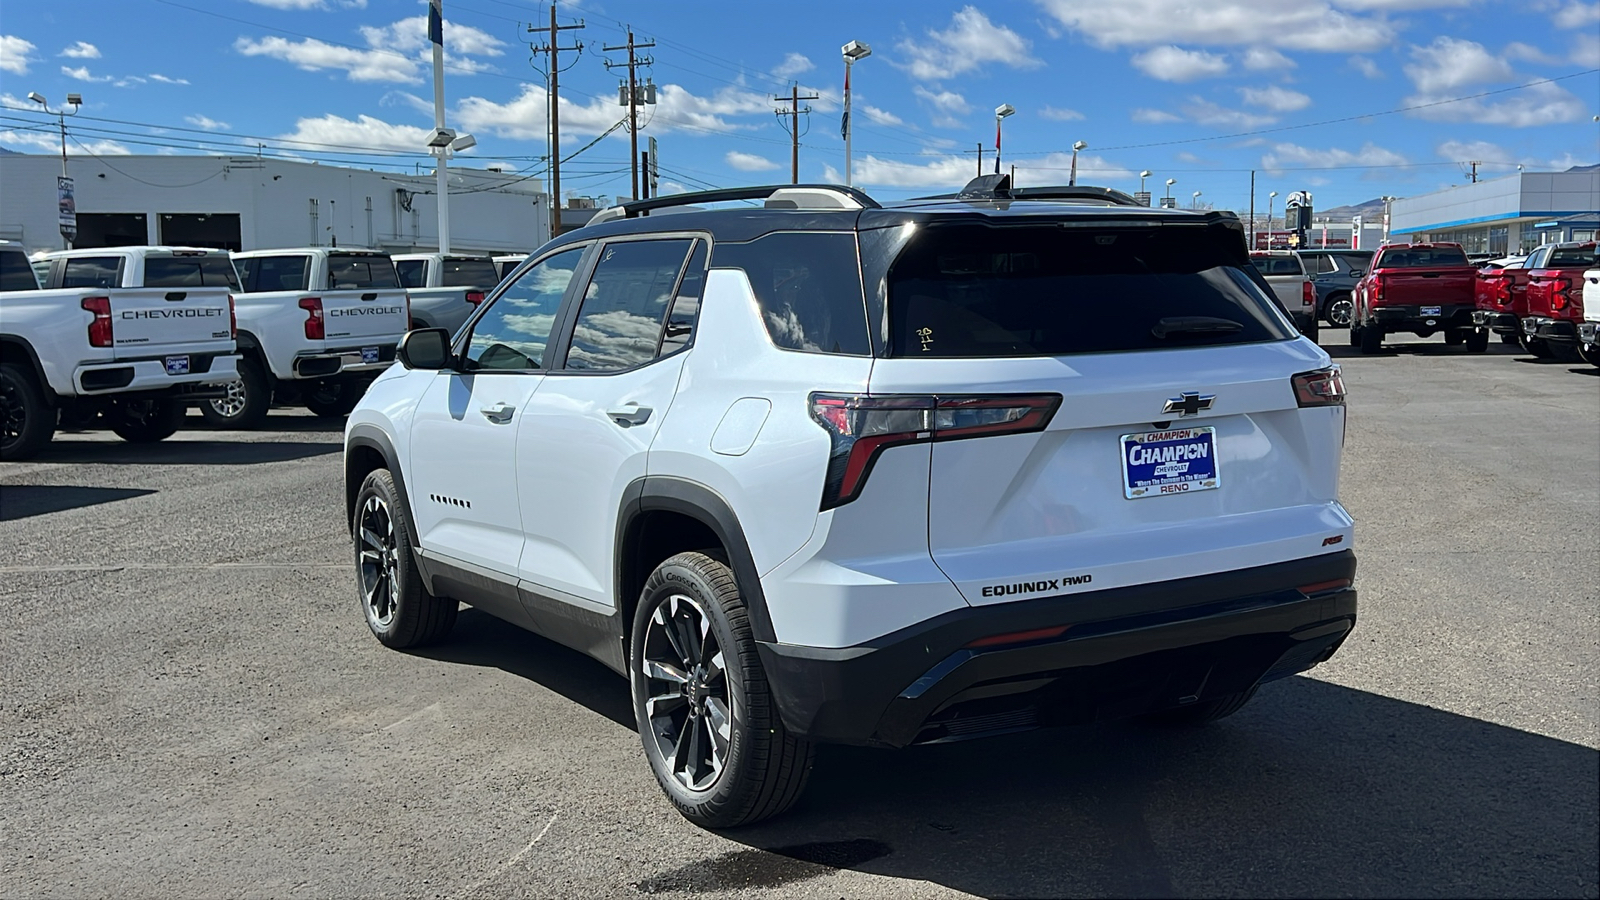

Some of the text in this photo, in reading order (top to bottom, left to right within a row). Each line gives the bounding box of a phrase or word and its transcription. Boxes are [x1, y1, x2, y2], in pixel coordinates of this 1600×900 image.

[122, 309, 224, 320] CHEVROLET
[331, 307, 403, 317] CHEVROLET
[1147, 430, 1191, 442] CHAMPION
[1129, 443, 1208, 466] CHAMPION
[1156, 464, 1187, 474] CHEVROLET
[1161, 483, 1189, 493] RENO
[982, 575, 1092, 597] EQUINOX AWD
